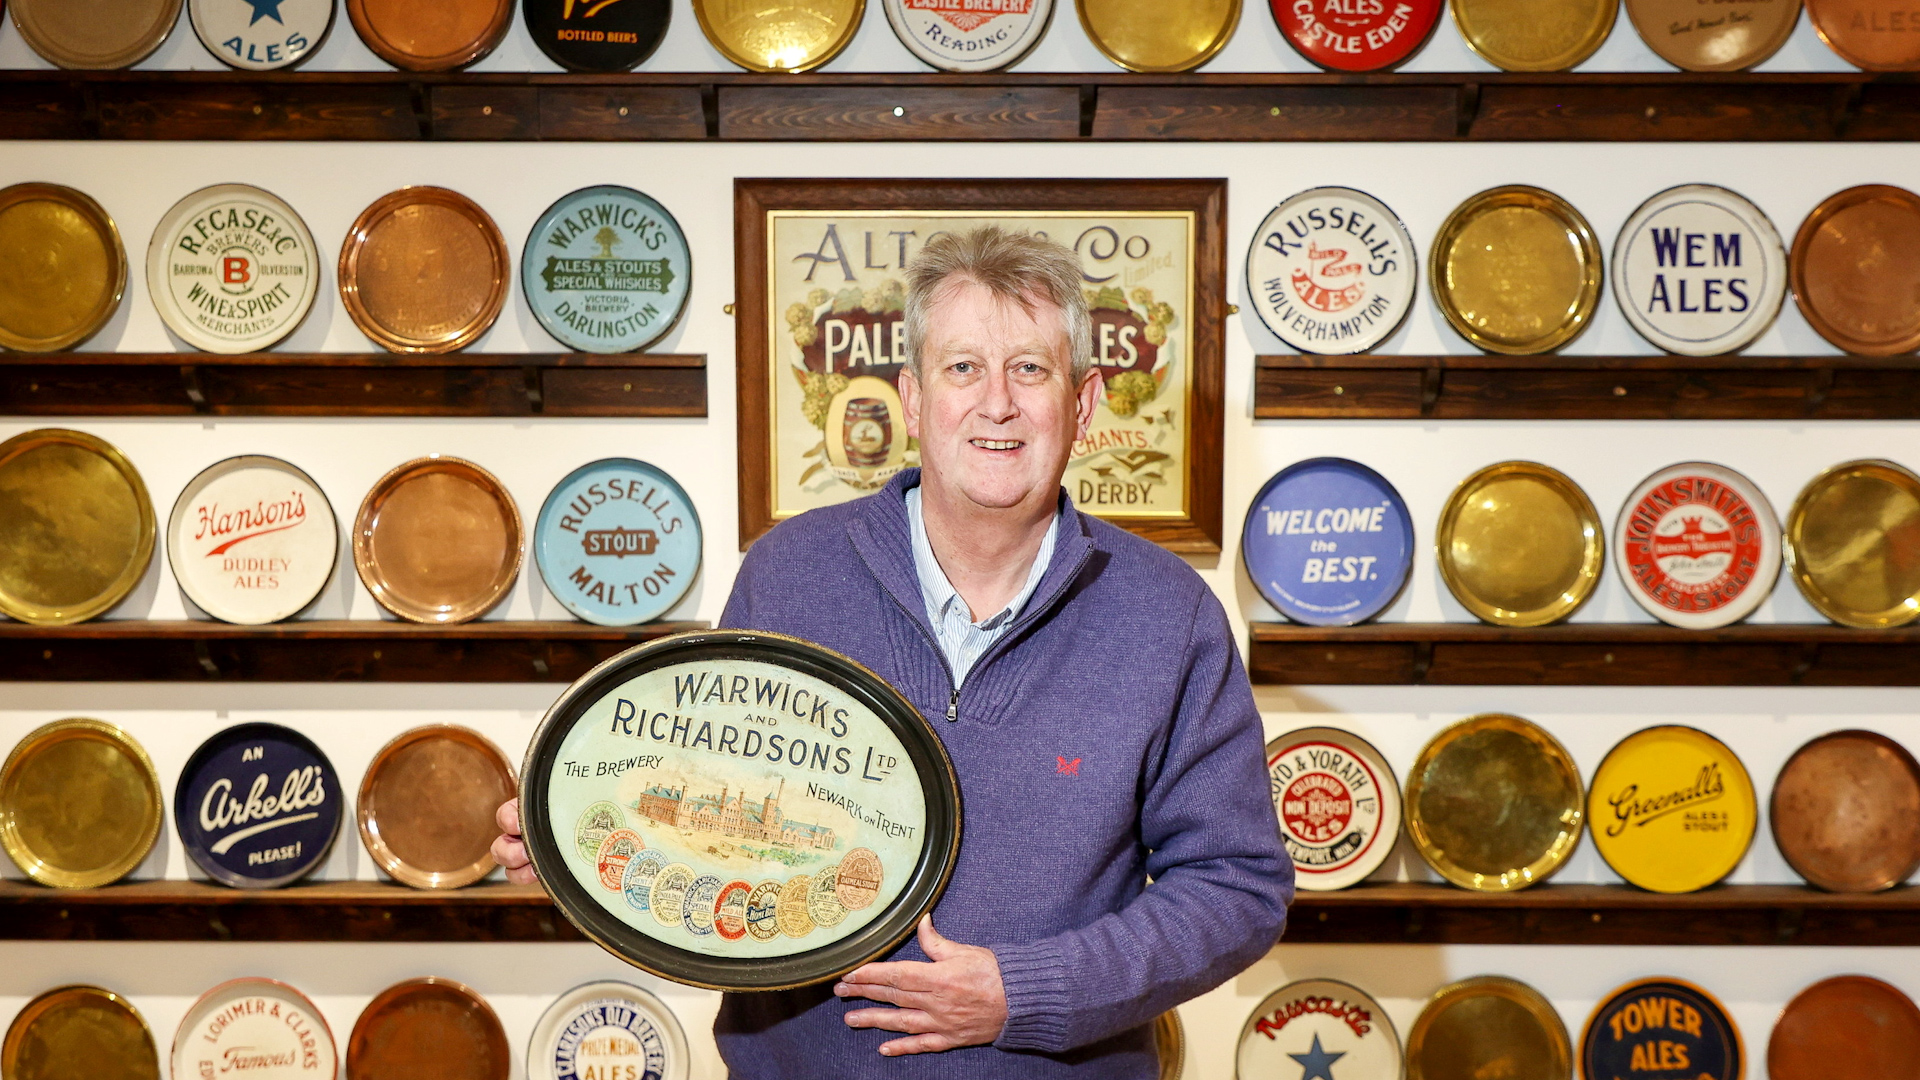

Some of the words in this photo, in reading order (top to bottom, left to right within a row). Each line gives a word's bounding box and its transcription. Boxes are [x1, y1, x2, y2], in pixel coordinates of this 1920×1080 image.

[1324, 0, 1384, 15] ALES
[557, 29, 605, 42] BOTTLED
[607, 31, 638, 44] BEERS
[925, 23, 1008, 51] READING
[1293, 1, 1362, 53] CASTLE
[1365, 3, 1413, 50] EDEN
[223, 32, 308, 62] ALES
[548, 204, 667, 251] WARWICK'S
[206, 233, 269, 256] BREWERS
[793, 224, 950, 281] ALT
[1265, 207, 1397, 276] RUSSELL'S
[1651, 227, 1742, 267] WEM
[224, 257, 250, 284] B
[261, 264, 303, 276] ULVERSTON
[555, 260, 591, 273] ALES
[593, 262, 602, 273] &
[604, 262, 662, 275] STOUTS
[553, 277, 602, 289] SPECIAL
[604, 278, 661, 291] WHISKIES
[1295, 282, 1364, 310] ALES
[1649, 274, 1750, 313] ALES
[584, 295, 630, 304] VICTORIA
[584, 305, 629, 313] BREWERY
[1264, 277, 1391, 341] WOLVERHAMPTON
[197, 314, 275, 334] MERCHANTS
[554, 301, 660, 338] DARLINGTON
[825, 319, 906, 374] PALE
[1071, 428, 1153, 459] CHANTS.
[1080, 479, 1154, 504] DERBY.
[195, 490, 307, 540] Hanson's
[559, 478, 683, 535] RUSSELLS
[1628, 487, 1673, 552] JOHN
[1672, 479, 1757, 545] SMITHS
[589, 533, 651, 552] STOUT
[1310, 540, 1337, 552] the
[223, 558, 292, 572] DUDLEY
[1302, 556, 1378, 583] BEST.
[234, 575, 279, 589] ALES
[569, 562, 676, 606] MALTON
[1634, 563, 1680, 607] ALES
[1694, 556, 1755, 610] STOUT
[674, 671, 850, 738] WARWICKS
[744, 713, 777, 727] AND
[611, 698, 852, 775] RICHARDSONS
[242, 746, 264, 762] AN
[564, 761, 590, 777] THE
[596, 755, 664, 777] BREWERY
[1272, 764, 1293, 803] OYD
[1295, 755, 1307, 771] &
[1308, 750, 1369, 792] YORATH
[805, 781, 862, 819] NEWARK
[876, 810, 916, 839] TRENT
[1285, 800, 1307, 815] NON
[1684, 811, 1718, 820] ALES
[1290, 819, 1344, 840] ALES
[1684, 822, 1728, 832] STOUT
[248, 841, 302, 866] PLEASE!
[203, 999, 266, 1044] LORIMER
[270, 1002, 281, 1019] &
[605, 1006, 632, 1029] OLD
[1255, 996, 1371, 1040] Newcastle
[1609, 996, 1704, 1041] TOWER
[220, 1046, 297, 1073] Famous
[1630, 1040, 1691, 1071] ALES
[585, 1065, 637, 1080] ALES
